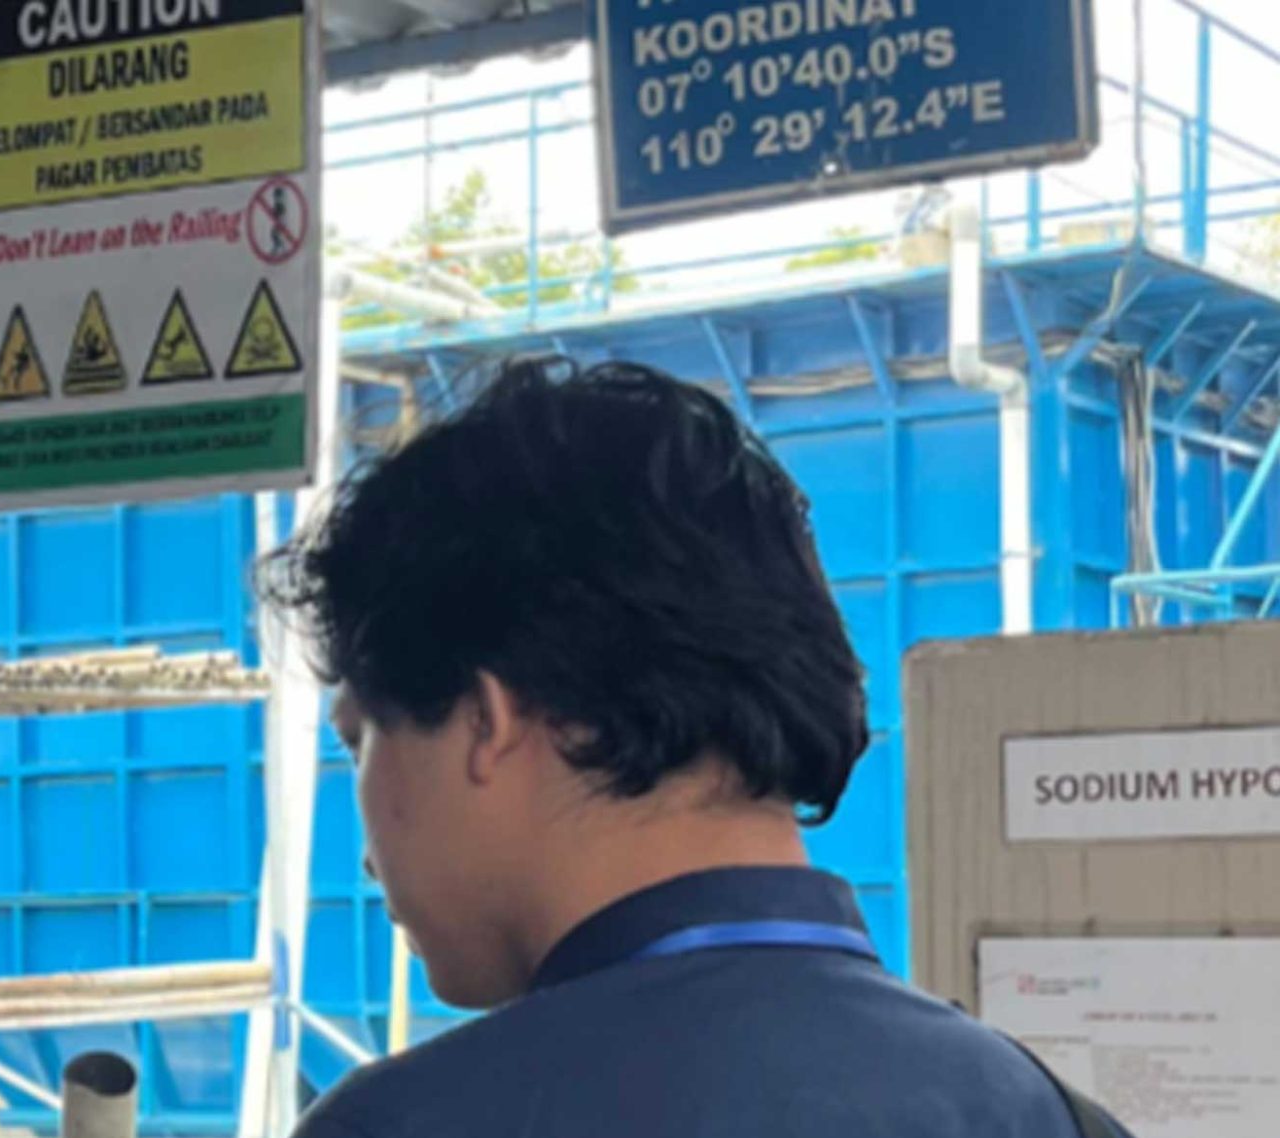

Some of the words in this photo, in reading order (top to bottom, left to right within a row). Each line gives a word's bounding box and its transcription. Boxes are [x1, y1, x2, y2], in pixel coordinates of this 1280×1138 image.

[49, 41, 189, 98] DILARANG
[78, 118, 91, 150] /
[97, 100, 212, 140] BERSANDAR
[219, 92, 270, 120] PADA
[36, 160, 96, 193] PAGAR
[101, 145, 204, 185] PEMBATAS
[49, 228, 97, 258] Lean
[99, 226, 127, 248] on
[131, 216, 162, 246] the
[167, 208, 243, 245] Railing
[1034, 770, 1180, 805] SODIUM
[1192, 766, 1280, 798] HYPO
